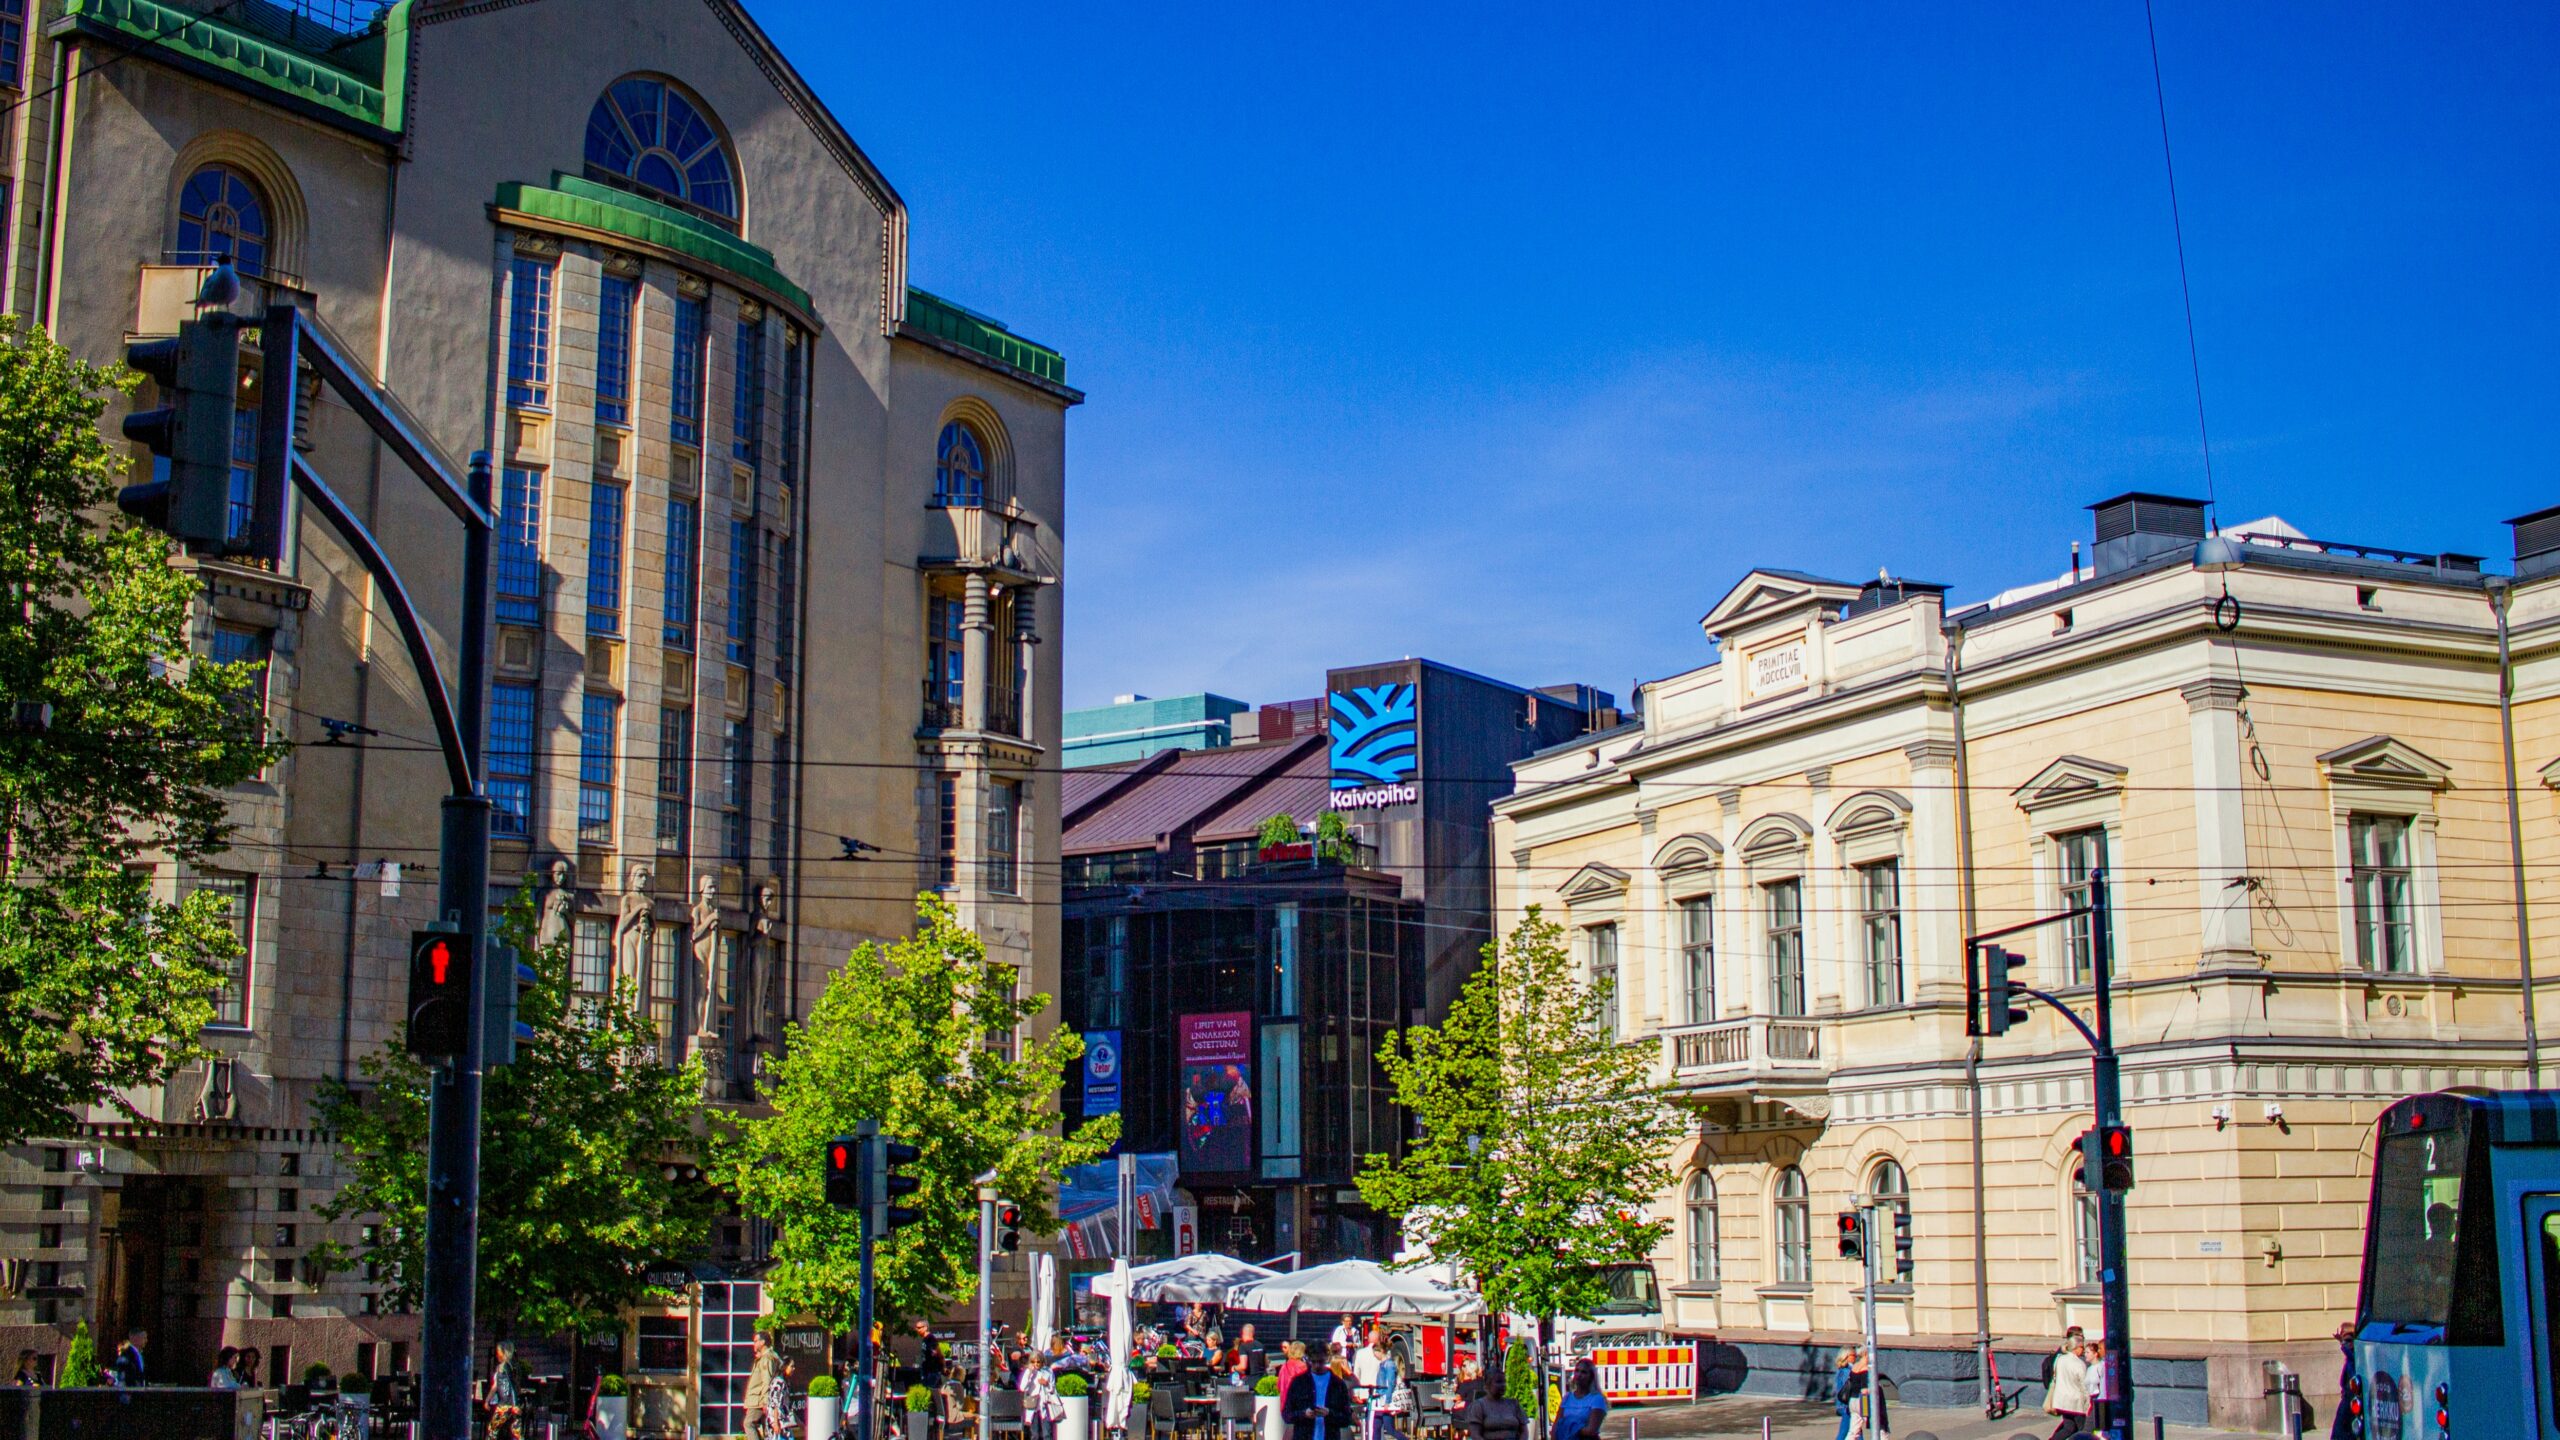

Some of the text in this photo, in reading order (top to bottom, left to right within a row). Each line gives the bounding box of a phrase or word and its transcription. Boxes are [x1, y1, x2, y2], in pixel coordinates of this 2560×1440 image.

[1758, 648, 1799, 672] PRIMITIAE
[1330, 784, 1416, 809] Kaivopiha
[1216, 1020, 1237, 1028] VAIN
[2426, 1137, 2436, 1170] 2
